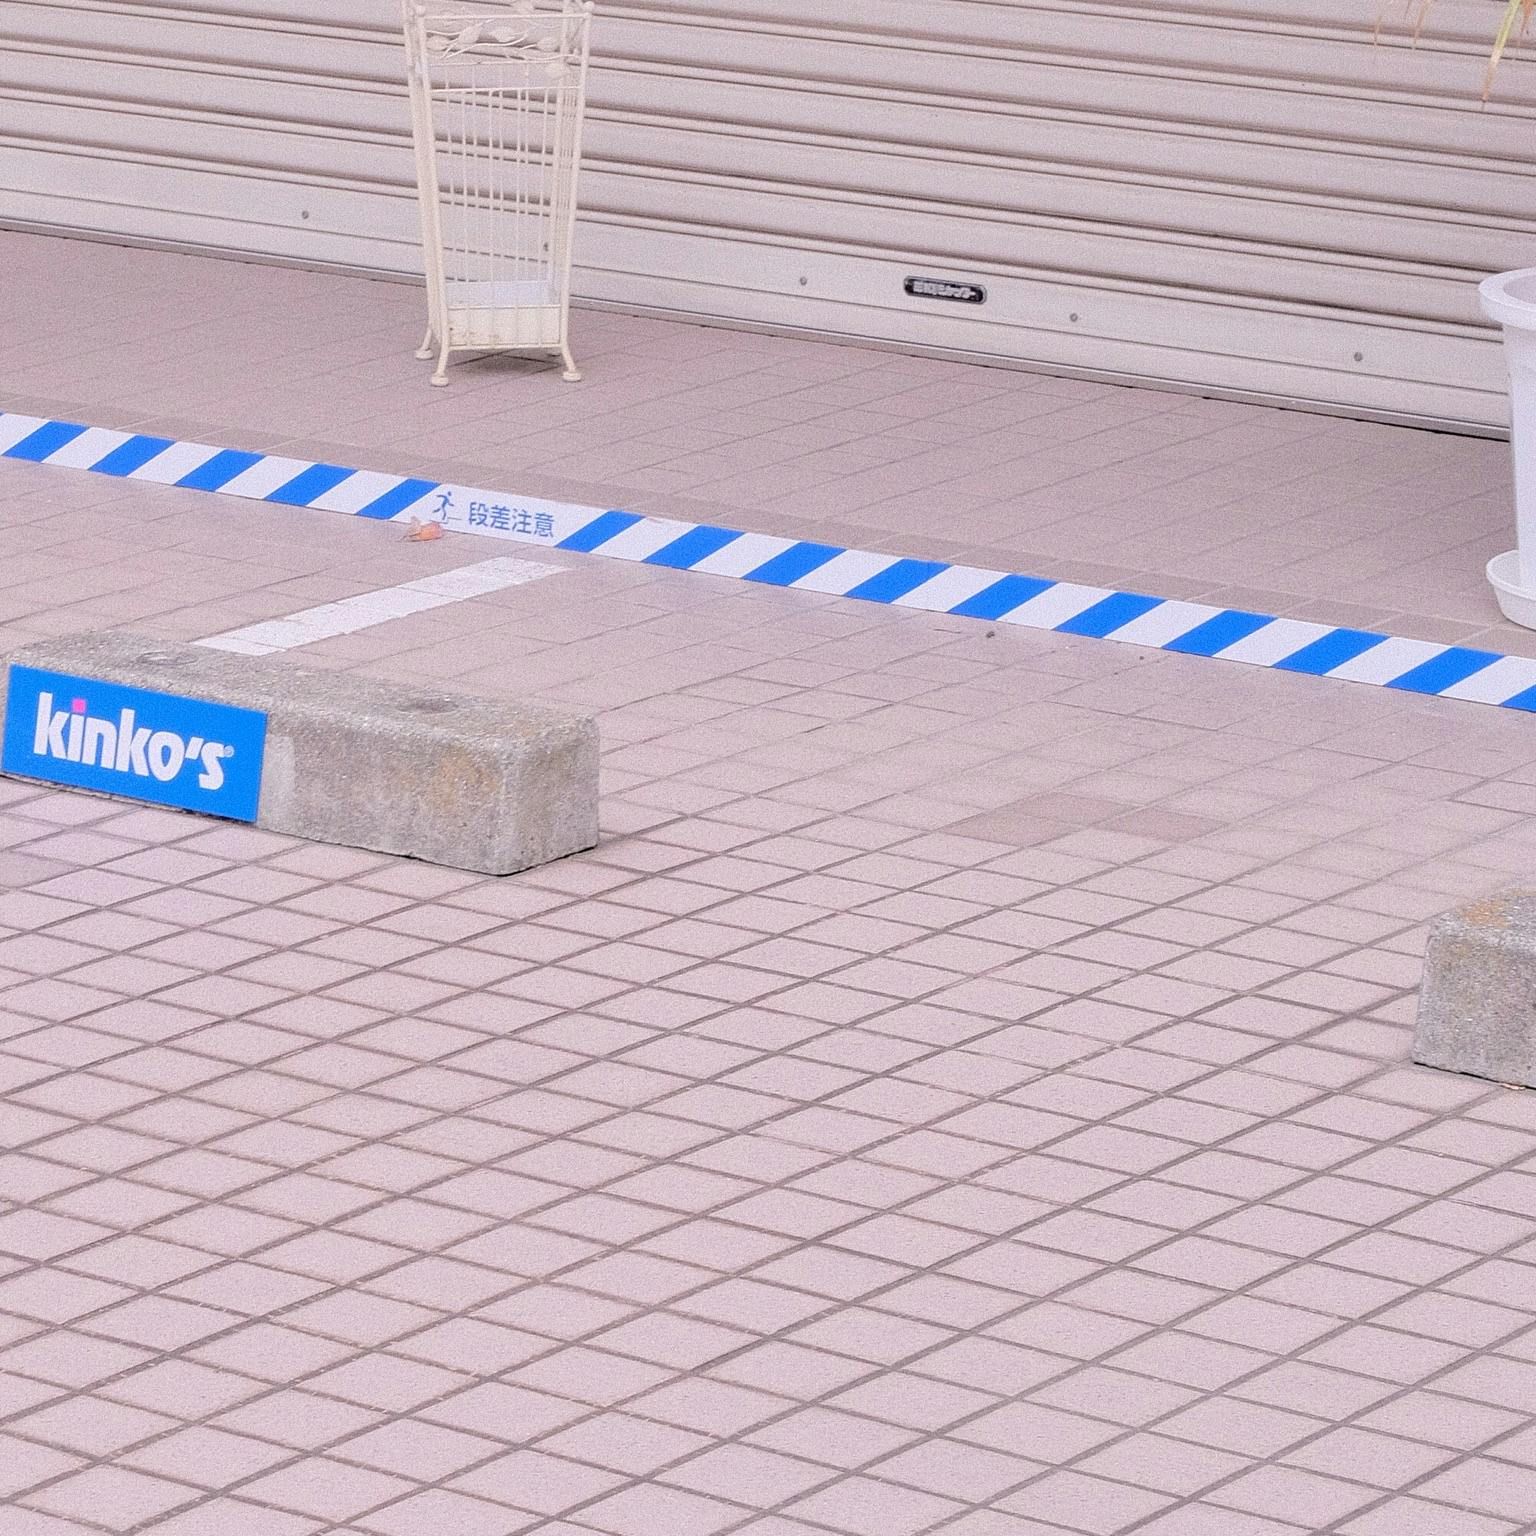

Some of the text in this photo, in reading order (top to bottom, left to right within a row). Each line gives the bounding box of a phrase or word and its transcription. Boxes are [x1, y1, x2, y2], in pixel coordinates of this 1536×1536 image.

[469, 501, 554, 537] 段差注意
[33, 691, 226, 791] kinko's
